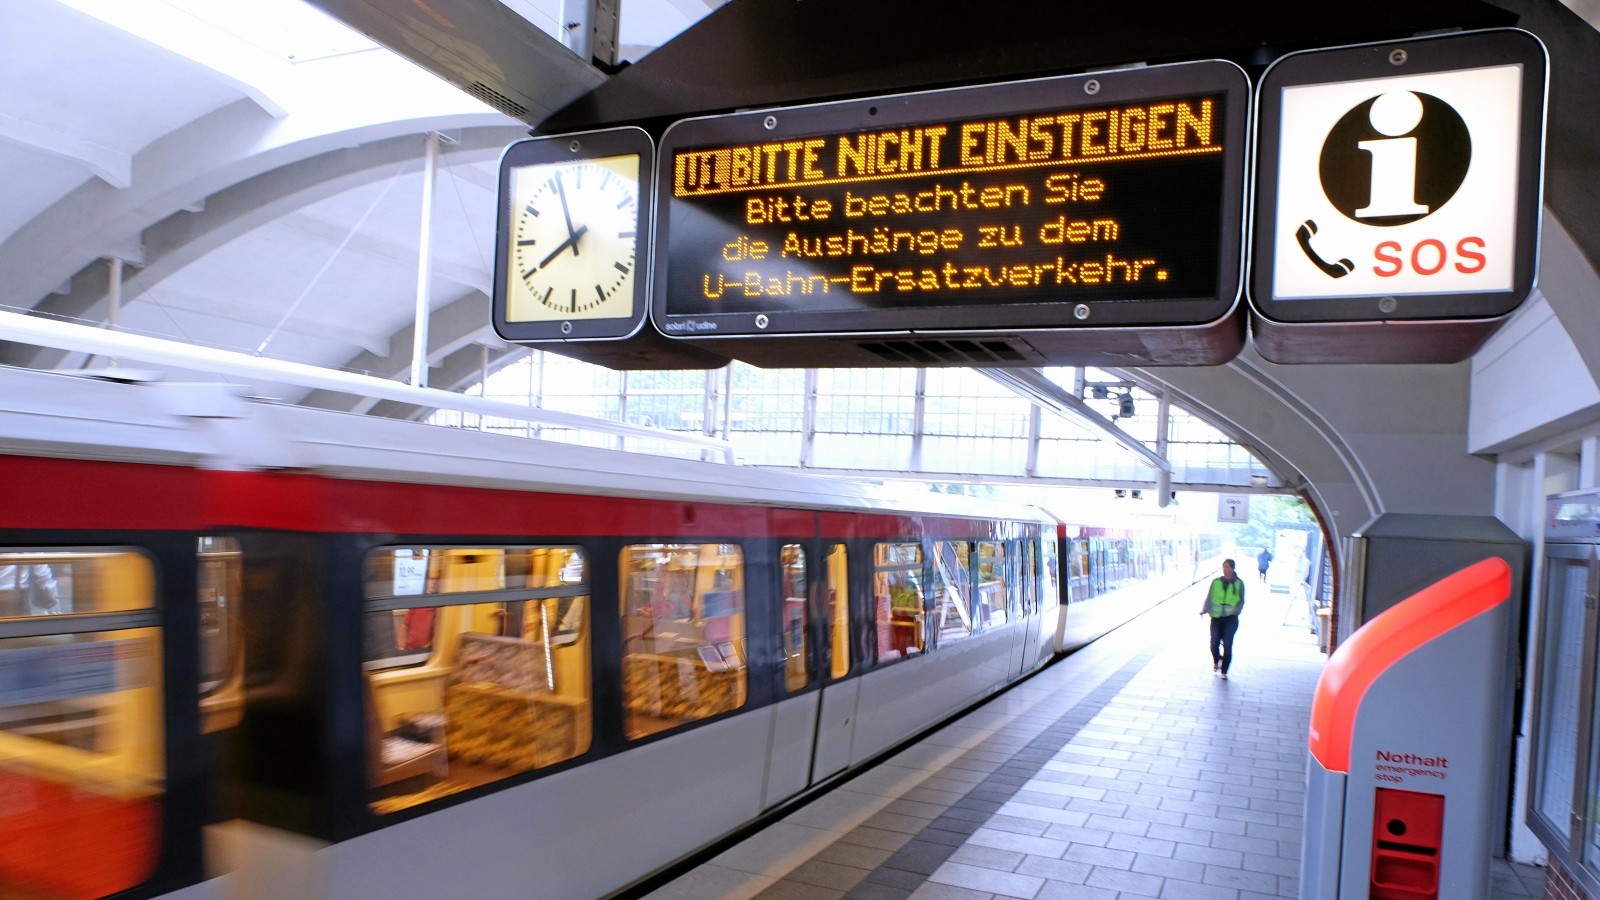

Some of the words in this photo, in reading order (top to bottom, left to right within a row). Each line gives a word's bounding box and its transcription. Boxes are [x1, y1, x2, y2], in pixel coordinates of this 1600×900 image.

[682, 153, 723, 194] U1
[731, 139, 825, 186] BITTE
[837, 127, 947, 176] NICHT
[961, 100, 1212, 166] EINSTEIGEN
[746, 196, 832, 225] Bitte
[845, 182, 1029, 217] beachten
[1045, 173, 1105, 204] Sie
[722, 236, 769, 262] die
[781, 227, 963, 258] Aushänge
[978, 226, 1023, 247] zu
[1040, 216, 1119, 244] dem
[1372, 236, 1487, 277] SOS
[703, 254, 1168, 299] U-Bahn-Ersatzverkehr.
[1230, 506, 1236, 517] 1
[1375, 773, 1403, 783] stop
[1376, 750, 1448, 769] Nothalt
[1376, 764, 1446, 779] emergency
